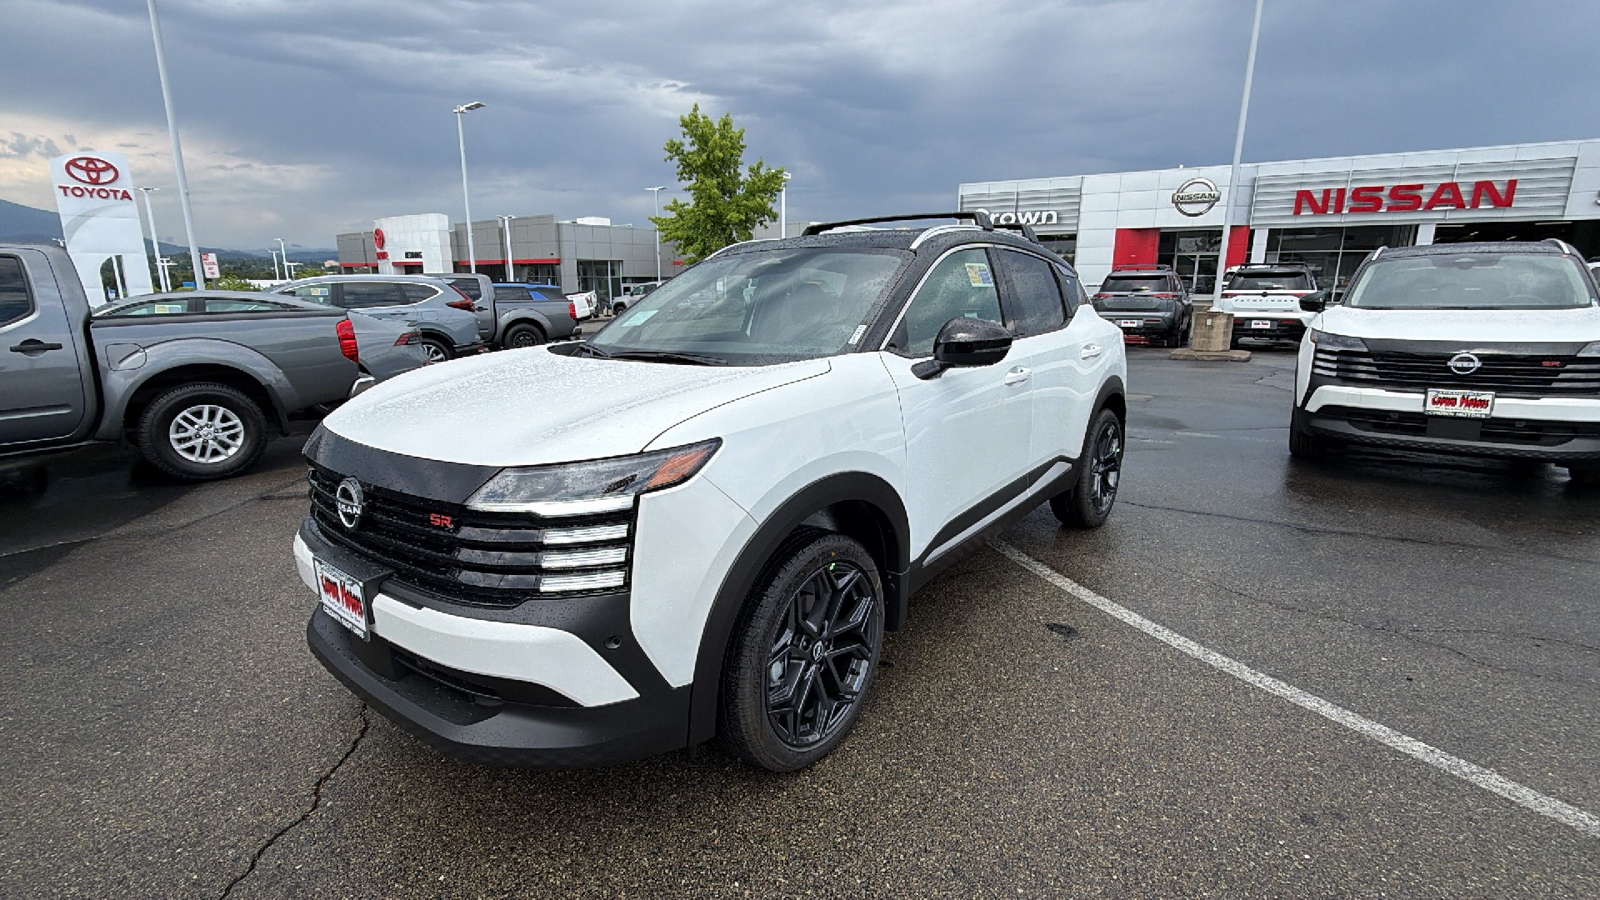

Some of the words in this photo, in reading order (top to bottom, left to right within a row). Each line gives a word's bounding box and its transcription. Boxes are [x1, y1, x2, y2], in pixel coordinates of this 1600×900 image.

[58, 185, 133, 201] TOYOTA
[1176, 193, 1216, 201] NISSAN
[1293, 179, 1518, 216] NISSAN
[337, 502, 361, 514] SSAN
[429, 513, 452, 528] SR
